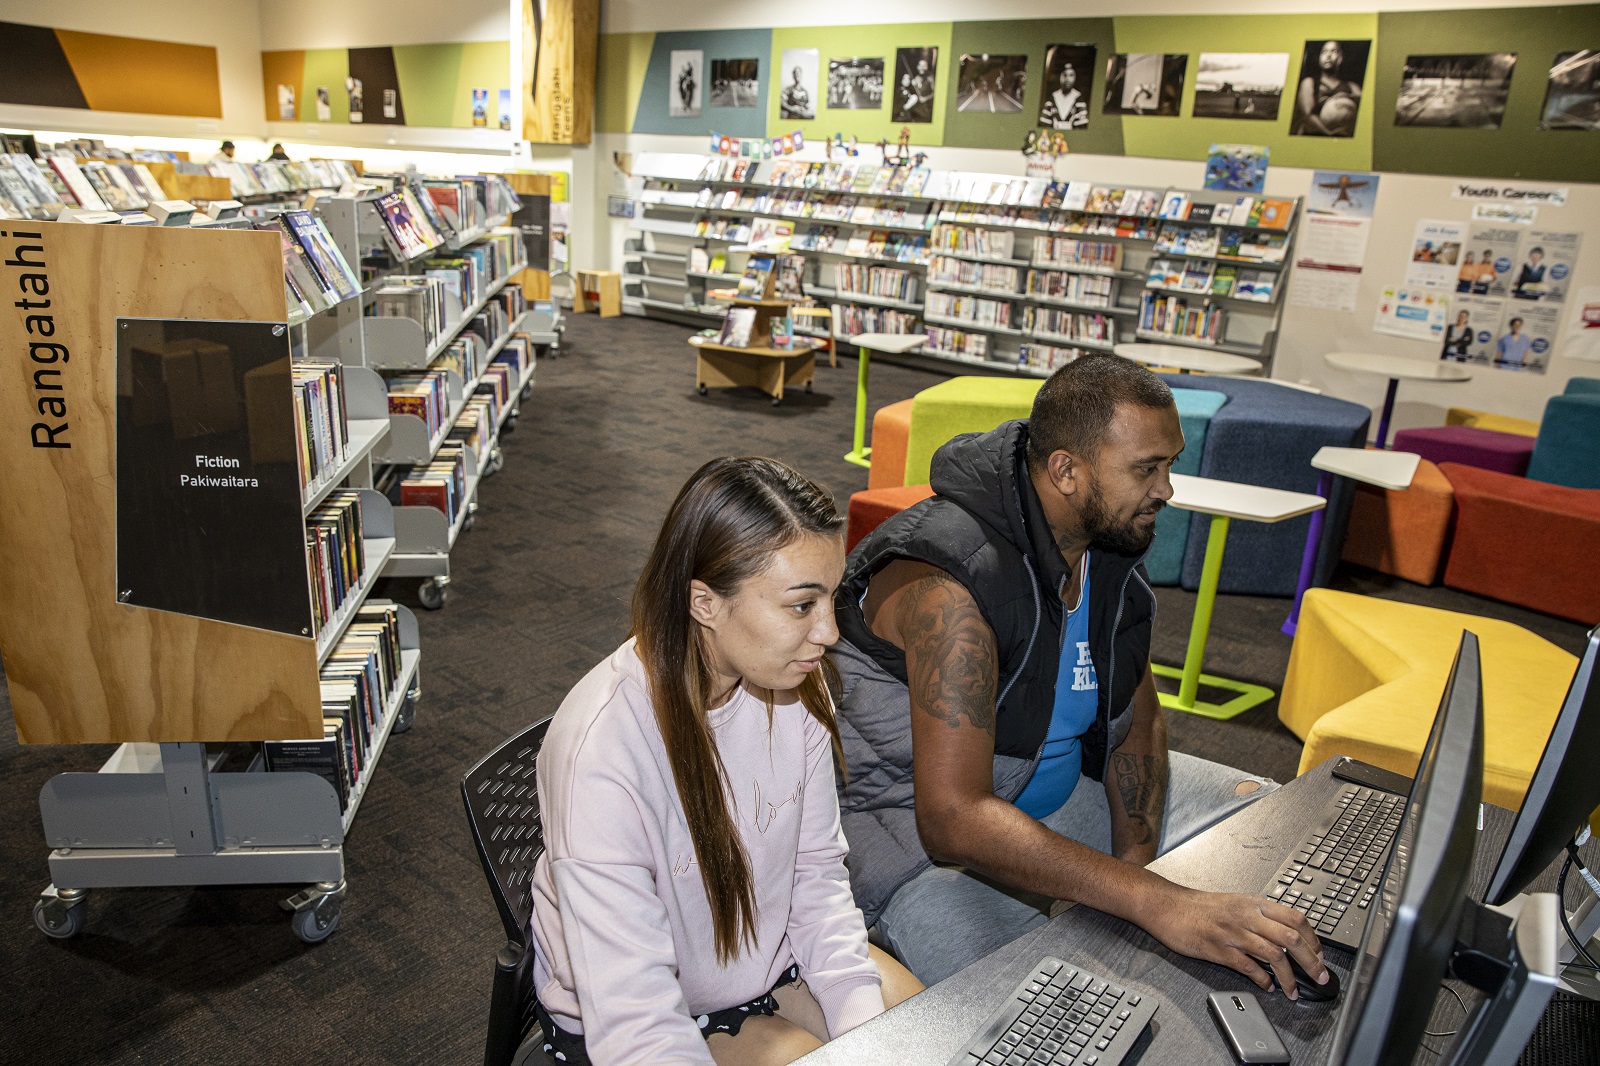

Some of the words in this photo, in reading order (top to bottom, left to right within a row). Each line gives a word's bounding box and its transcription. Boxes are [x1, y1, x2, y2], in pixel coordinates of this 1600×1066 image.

[1458, 184, 1499, 198] Youth
[1, 230, 72, 449] Rangatahi
[195, 454, 240, 468] Fiction
[180, 474, 259, 487] Pakiwaitara
[1071, 666, 1098, 690] KL
